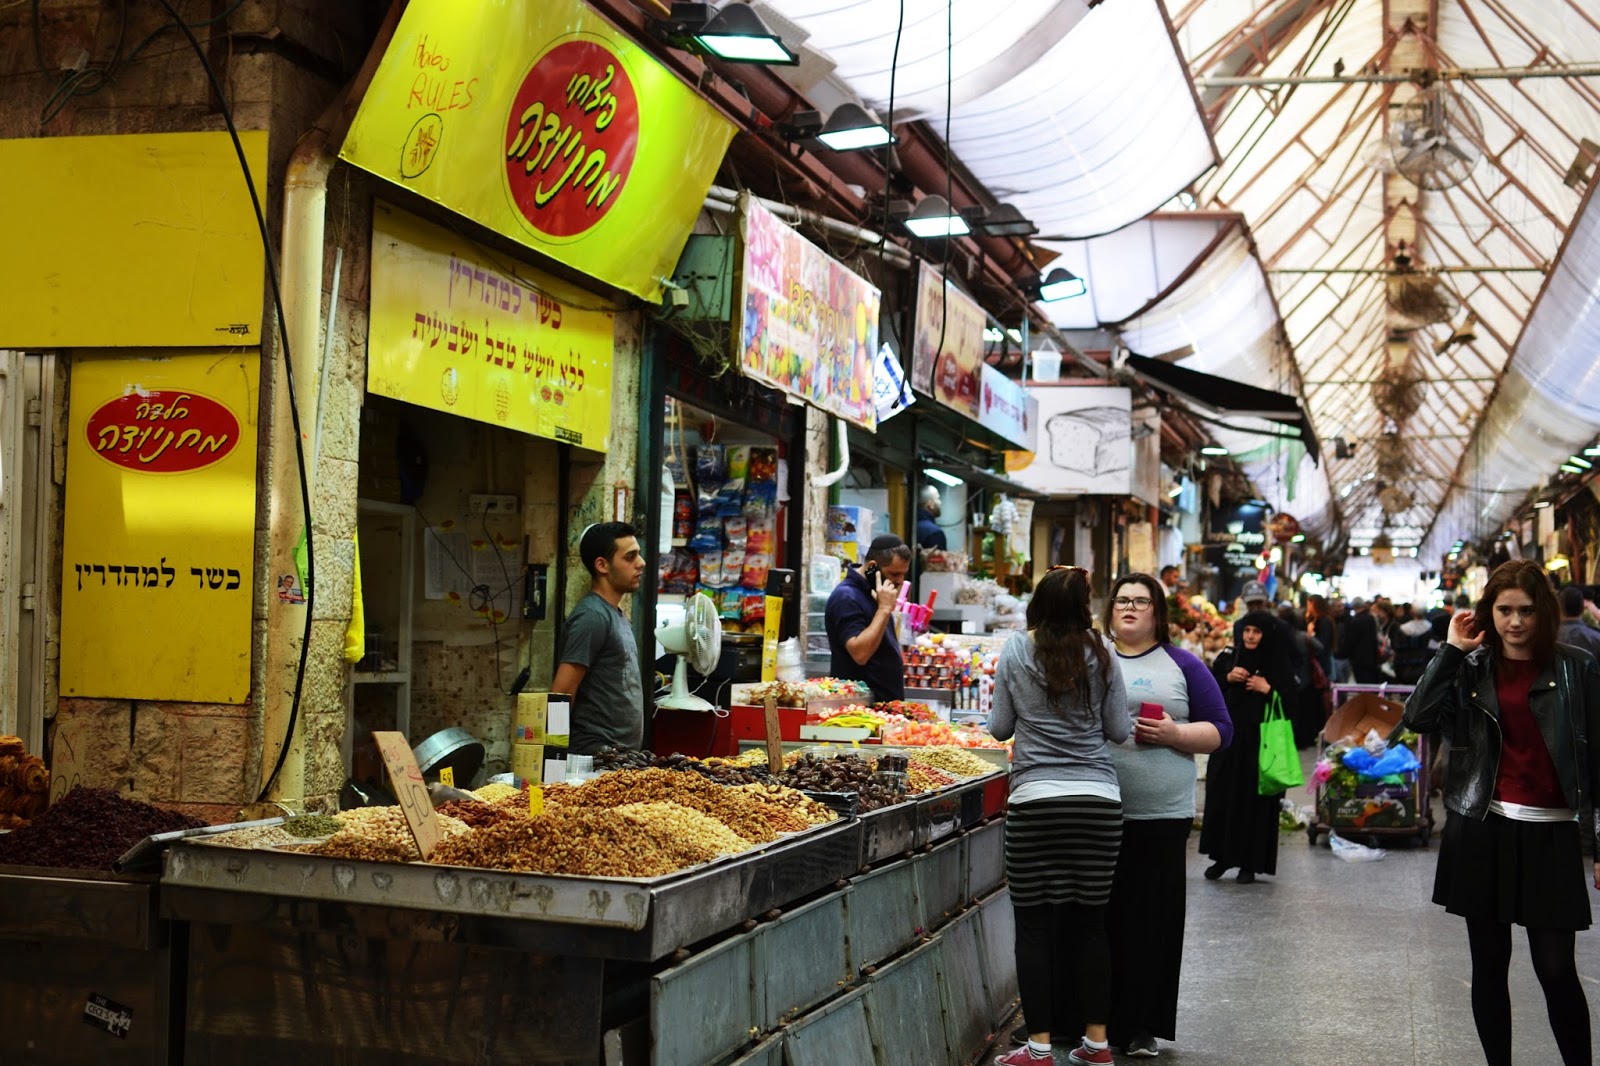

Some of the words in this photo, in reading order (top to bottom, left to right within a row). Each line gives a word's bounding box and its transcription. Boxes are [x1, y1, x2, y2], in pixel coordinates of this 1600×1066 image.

[407, 72, 479, 112] RULES
[448, 252, 522, 314] למהדרין
[530, 289, 562, 329] כשר
[486, 318, 517, 369] טבל
[559, 348, 585, 392] ללא
[135, 395, 191, 421] חלבה
[75, 557, 176, 592] למהדרין
[191, 566, 241, 590] כשר
[399, 783, 430, 827] 40
